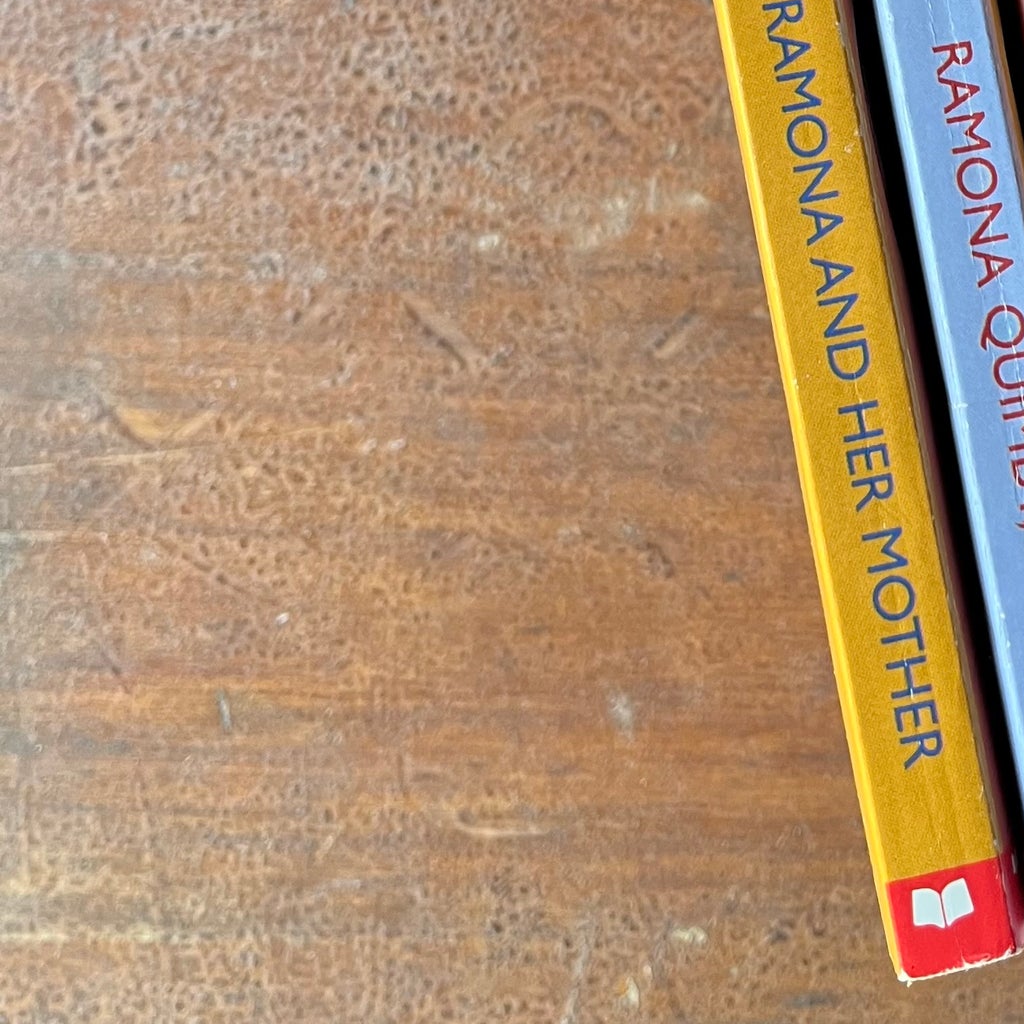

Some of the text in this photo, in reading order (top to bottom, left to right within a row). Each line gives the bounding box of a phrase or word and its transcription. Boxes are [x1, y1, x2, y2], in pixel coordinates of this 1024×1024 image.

[932, 40, 1015, 288] RAMONA
[809, 257, 871, 381] AND
[837, 399, 894, 513] HER
[861, 526, 944, 771] MOTHER
